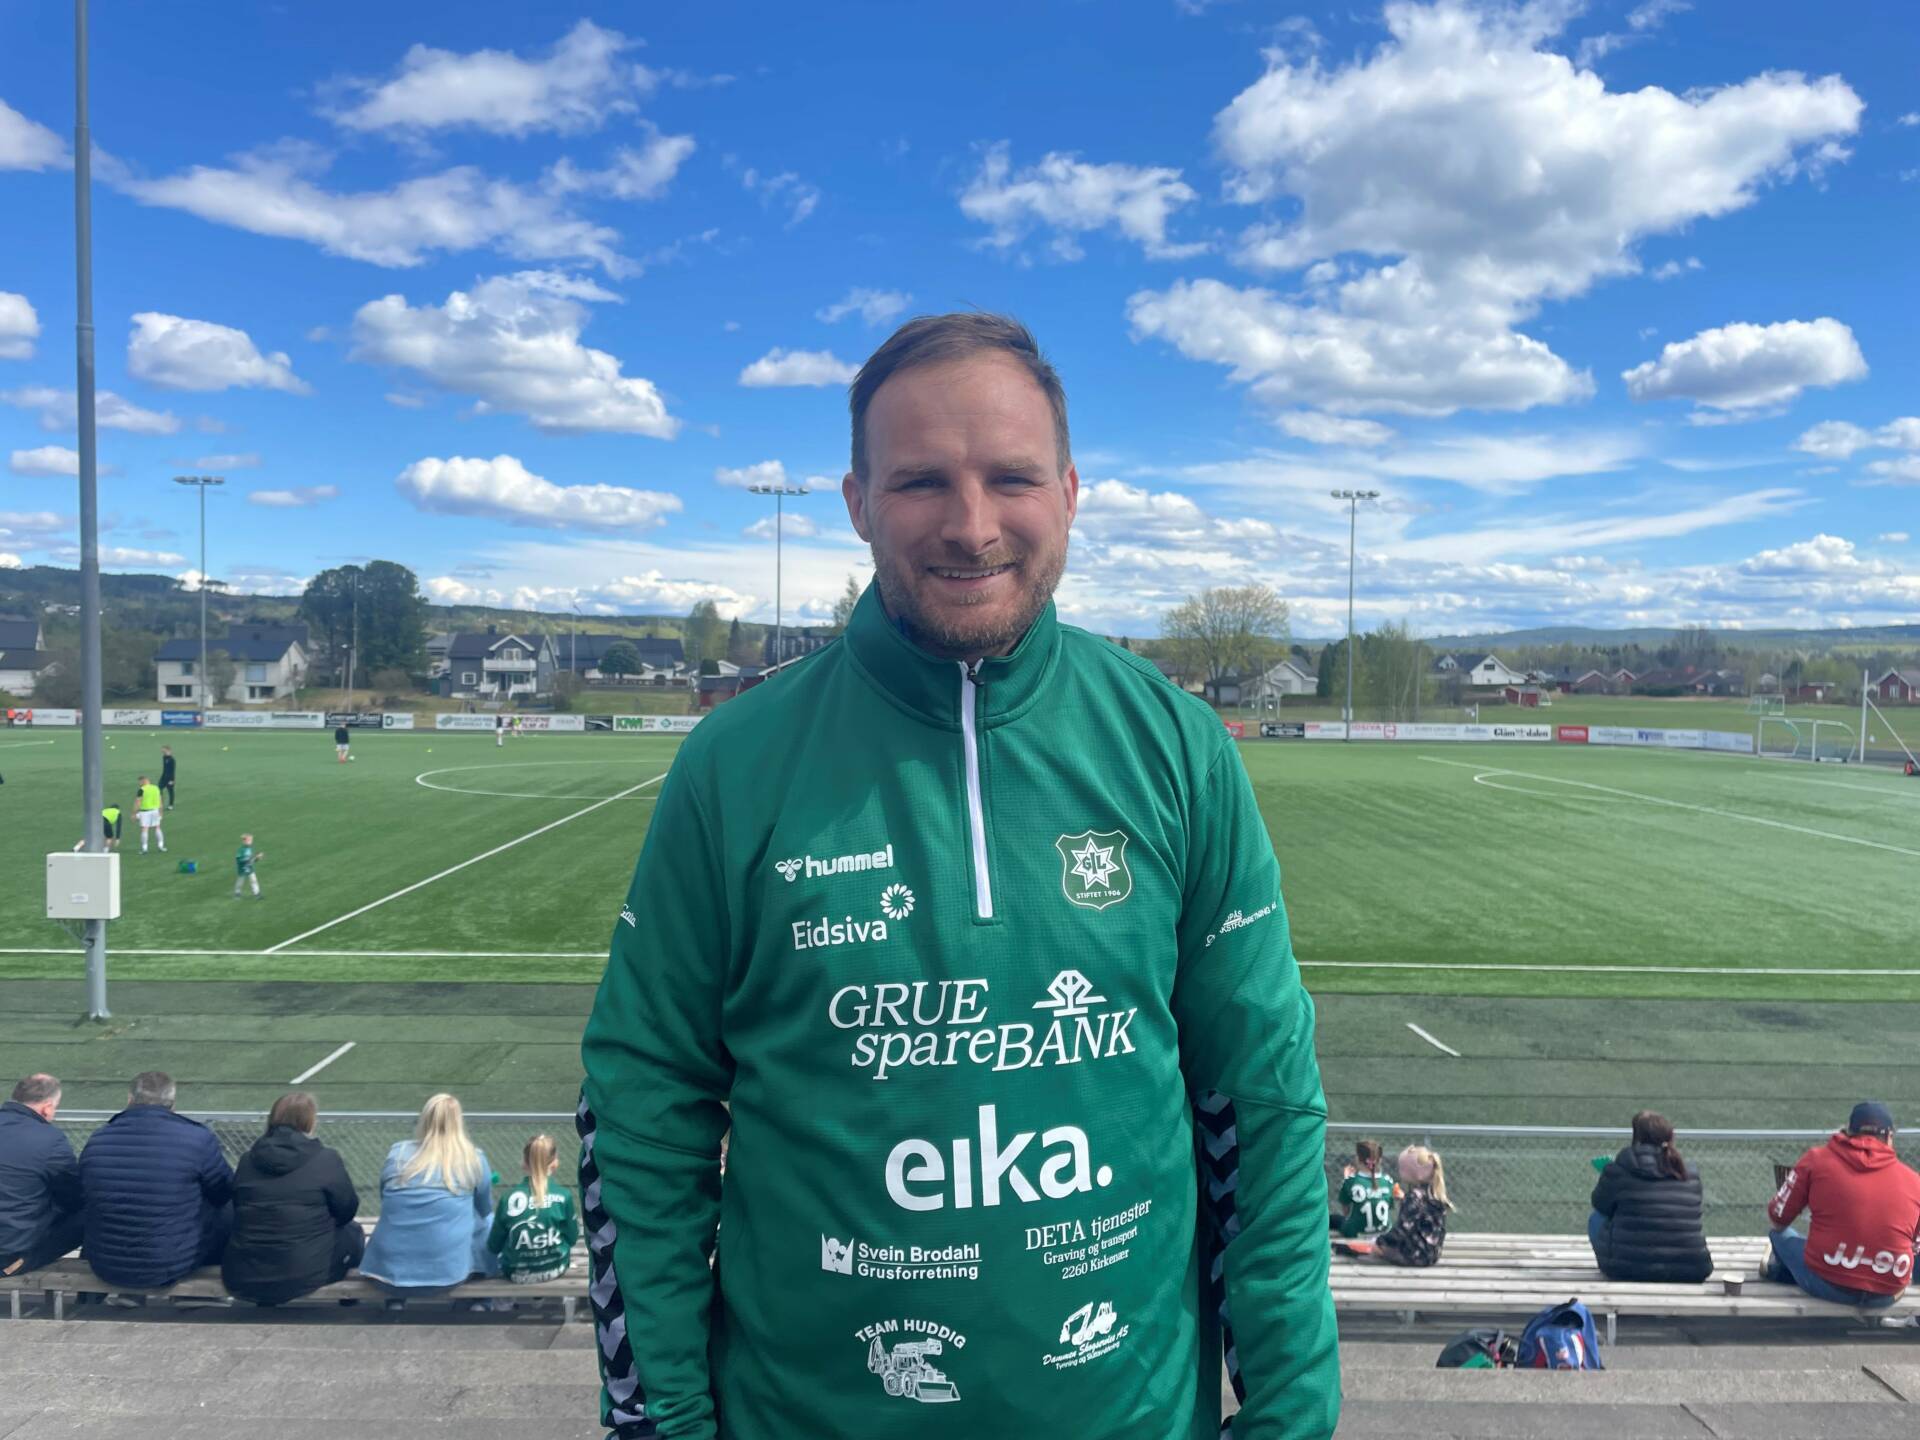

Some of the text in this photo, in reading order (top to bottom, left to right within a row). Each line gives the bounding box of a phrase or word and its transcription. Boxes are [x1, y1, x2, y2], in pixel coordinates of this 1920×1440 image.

[615, 717, 643, 730] KIWI
[805, 843, 894, 878] hummel
[1076, 889, 1121, 899] STIFTET 1906
[791, 915, 888, 951] Eidsiva
[828, 978, 989, 1029] GRUE
[851, 1007, 1138, 1080] spareBANK
[885, 1104, 1113, 1212] eika.
[1025, 1199, 1152, 1250] DETA tjenester
[1360, 1200, 1390, 1233] 19
[515, 1227, 561, 1250] Ask
[858, 1242, 980, 1262] Svein Brodahl
[1043, 1226, 1138, 1265] Graving og transport
[857, 1263, 978, 1281] Grusforretning
[1062, 1249, 1129, 1280] 2260 Kirkenær
[1823, 1242, 1911, 1278] JJ-90
[854, 1319, 967, 1349] TEAM HUDDIG
[1116, 1325, 1129, 1340] AS
